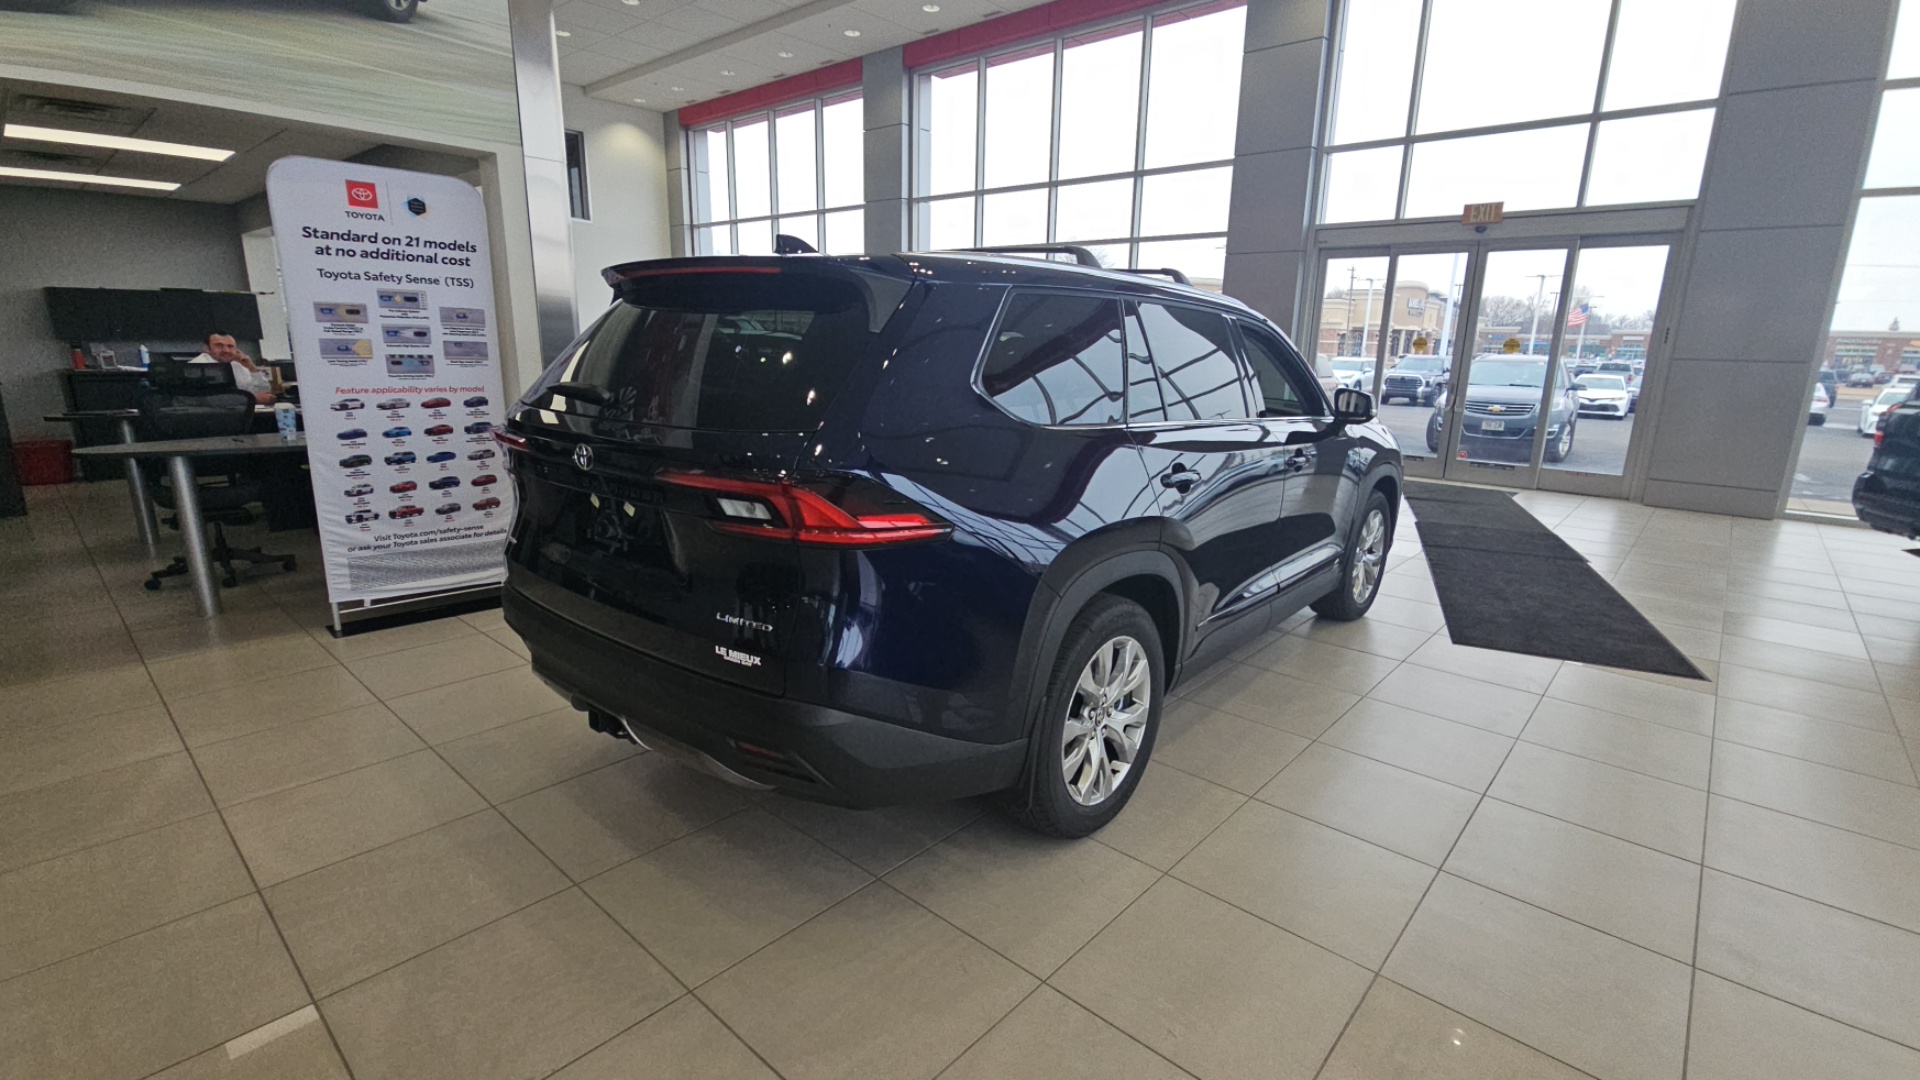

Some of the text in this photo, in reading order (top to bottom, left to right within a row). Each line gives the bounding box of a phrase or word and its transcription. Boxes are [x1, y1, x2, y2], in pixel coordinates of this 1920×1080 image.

[344, 211, 385, 222] TOYOTA
[1470, 204, 1496, 223] EXIT
[302, 226, 477, 253] Standard on 21 models
[315, 245, 471, 267] at no additional cost
[316, 268, 361, 281] Toyota
[364, 271, 403, 285] Safety
[444, 276, 474, 289] (TSS)
[371, 386, 422, 395] applicability
[449, 385, 458, 394] by
[460, 385, 485, 393] model
[358, 543, 372, 551] ask
[373, 543, 392, 551] your
[393, 540, 418, 549] Toyota
[419, 537, 437, 545] sales
[439, 533, 472, 543] associate
[484, 528, 508, 537] details
[374, 524, 484, 542] Visit Toyota.com/safety-sense
[716, 612, 773, 632] LIMITED
[715, 645, 762, 666] LE MIEUX
